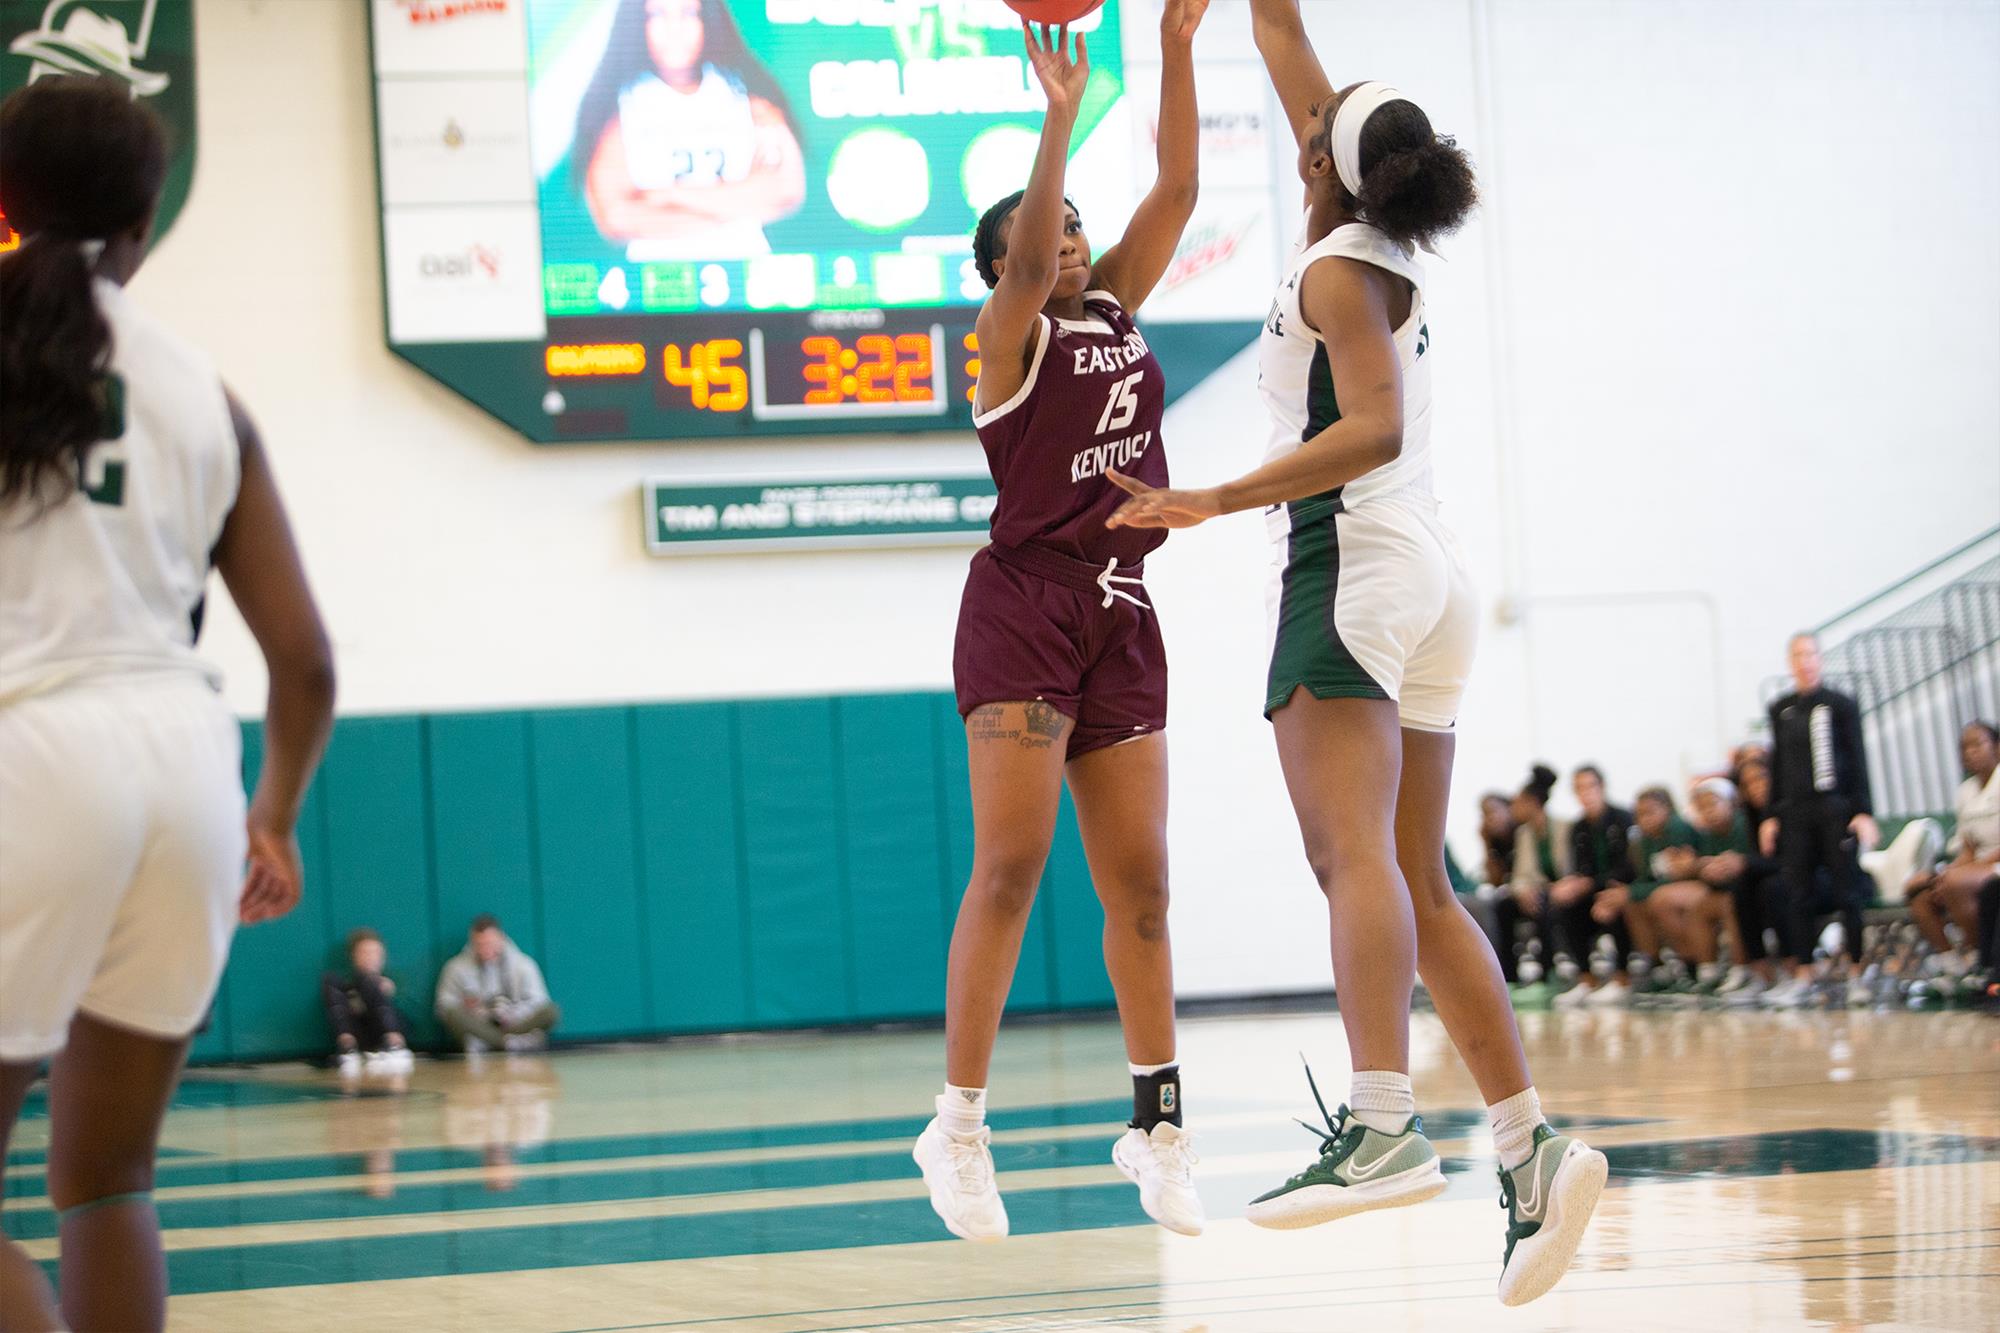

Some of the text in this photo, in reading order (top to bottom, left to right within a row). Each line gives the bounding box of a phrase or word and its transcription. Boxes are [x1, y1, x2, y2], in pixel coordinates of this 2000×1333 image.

[664, 340, 748, 411] 45
[801, 334, 933, 405] 3:22
[1094, 369, 1145, 435] 15
[720, 502, 791, 530] AND
